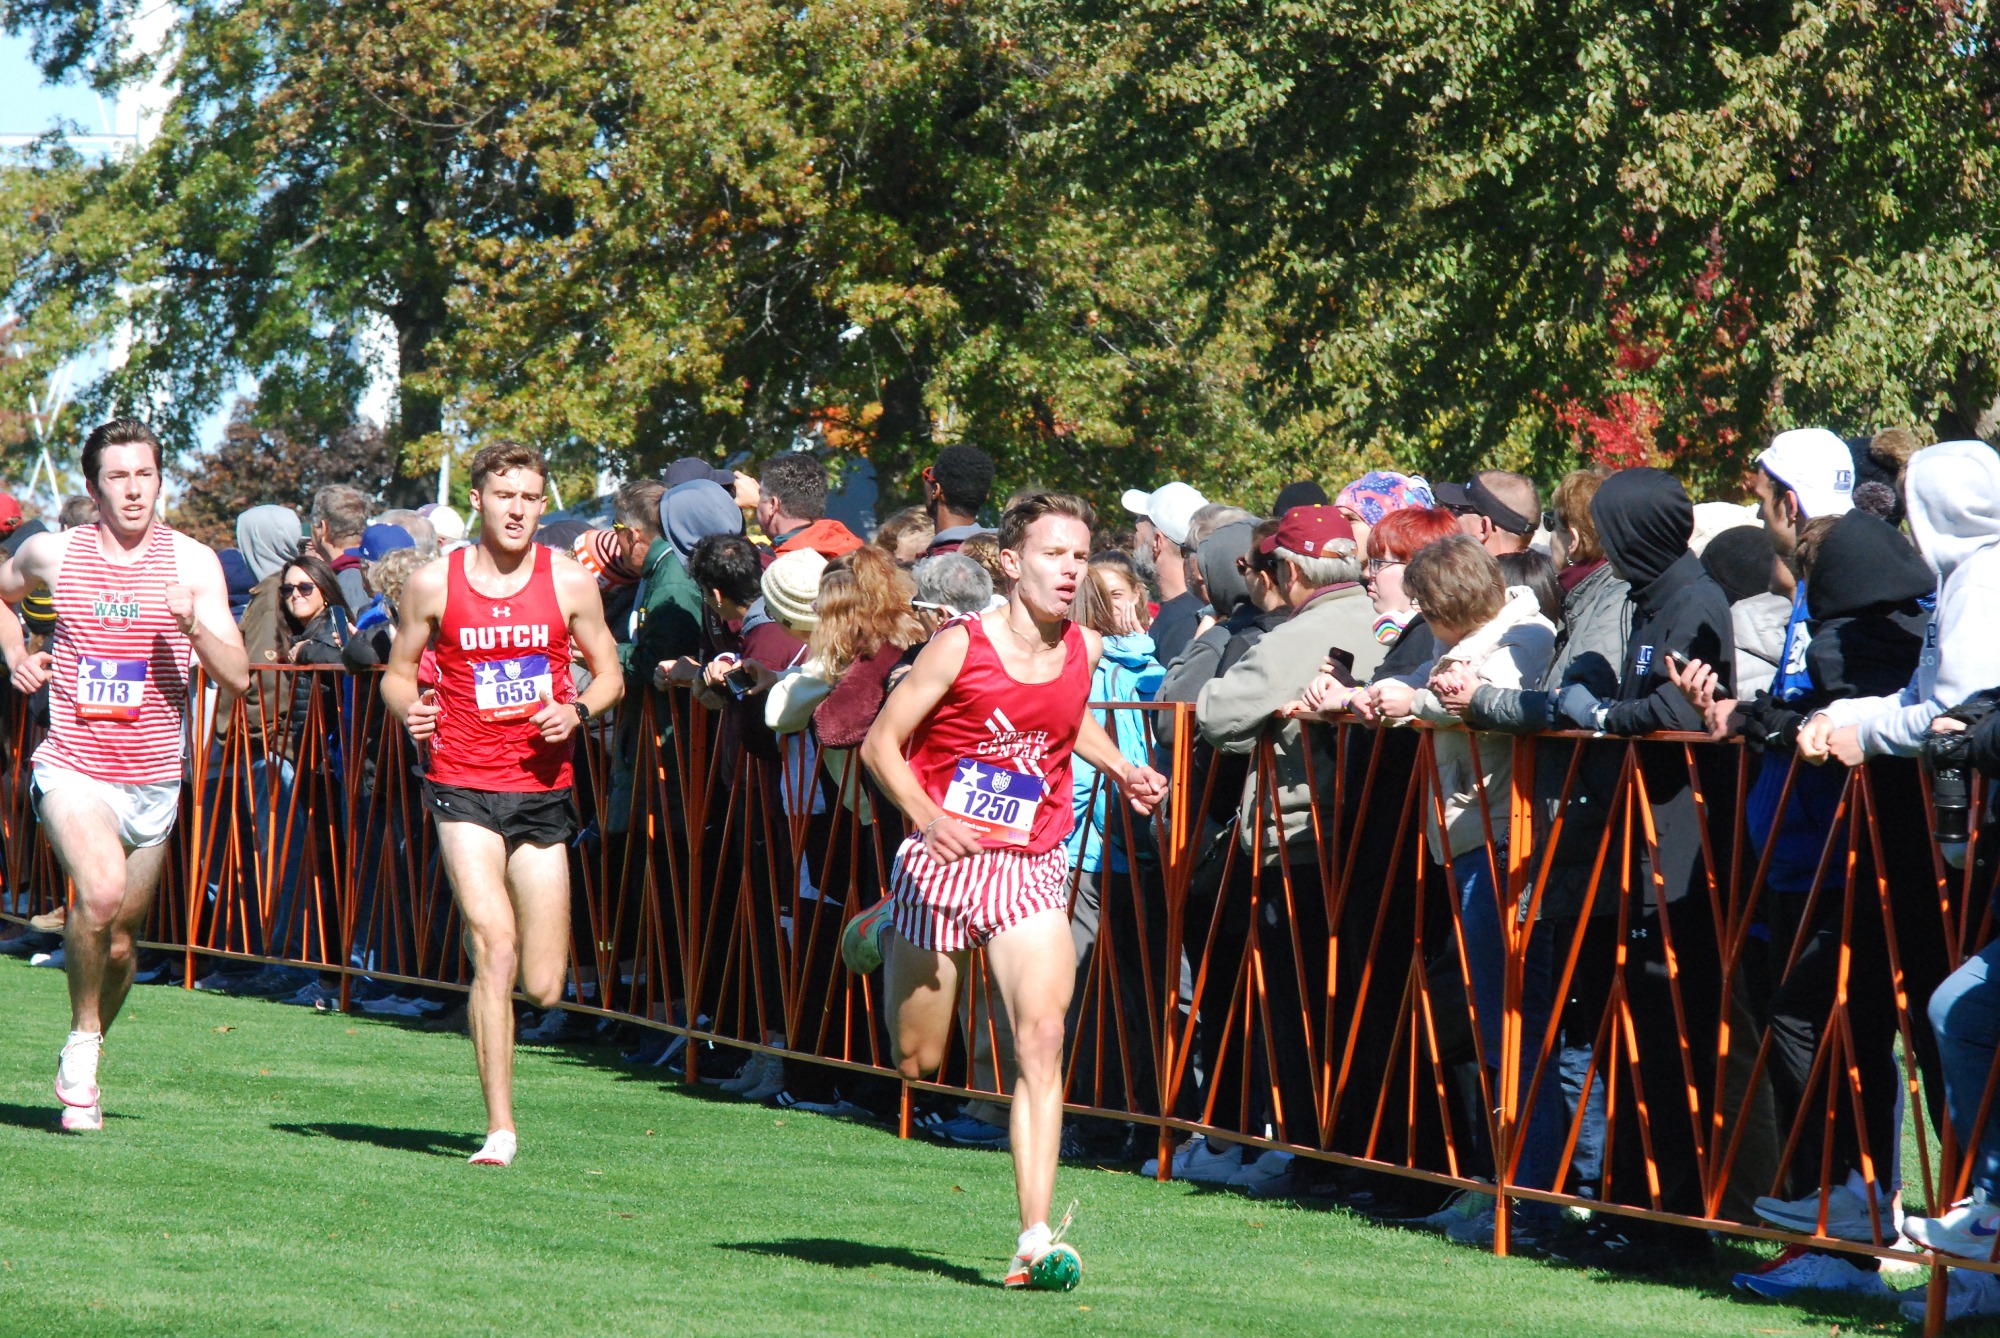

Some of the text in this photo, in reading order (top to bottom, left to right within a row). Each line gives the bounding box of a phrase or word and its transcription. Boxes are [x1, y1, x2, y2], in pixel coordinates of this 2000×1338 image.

[94, 601, 139, 619] WASH
[459, 624, 549, 651] DUTCH
[86, 681, 130, 704] 1713
[495, 679, 537, 706] 653
[992, 730, 1049, 745] NORTH
[963, 790, 1020, 824] 1250
